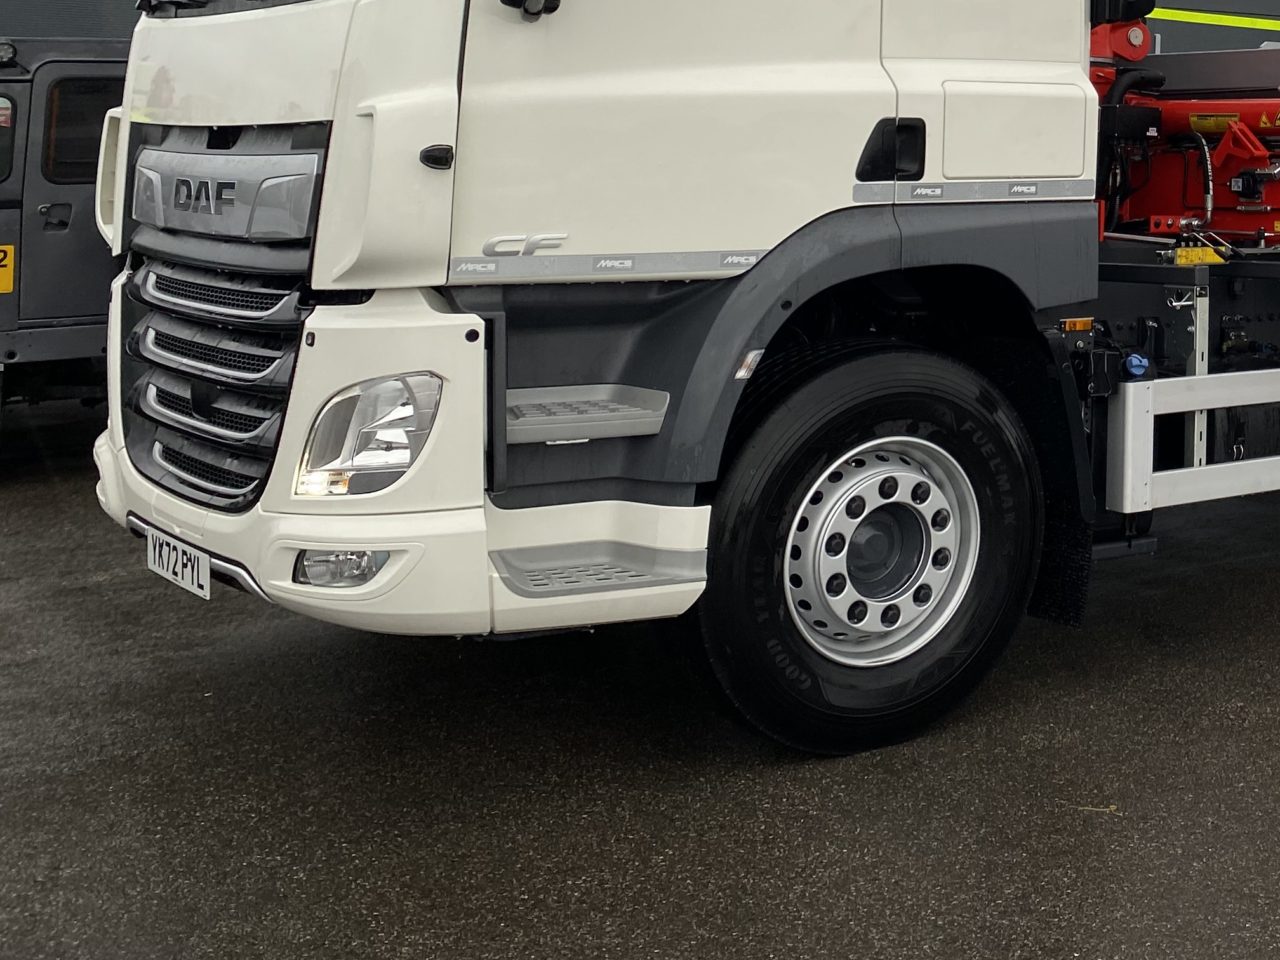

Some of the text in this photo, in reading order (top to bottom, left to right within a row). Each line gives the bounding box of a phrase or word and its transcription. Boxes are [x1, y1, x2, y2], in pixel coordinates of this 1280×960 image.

[174, 177, 237, 216] DAF
[482, 233, 569, 257] CF
[596, 258, 633, 269] MACS
[151, 533, 205, 591] YK72 PYL
